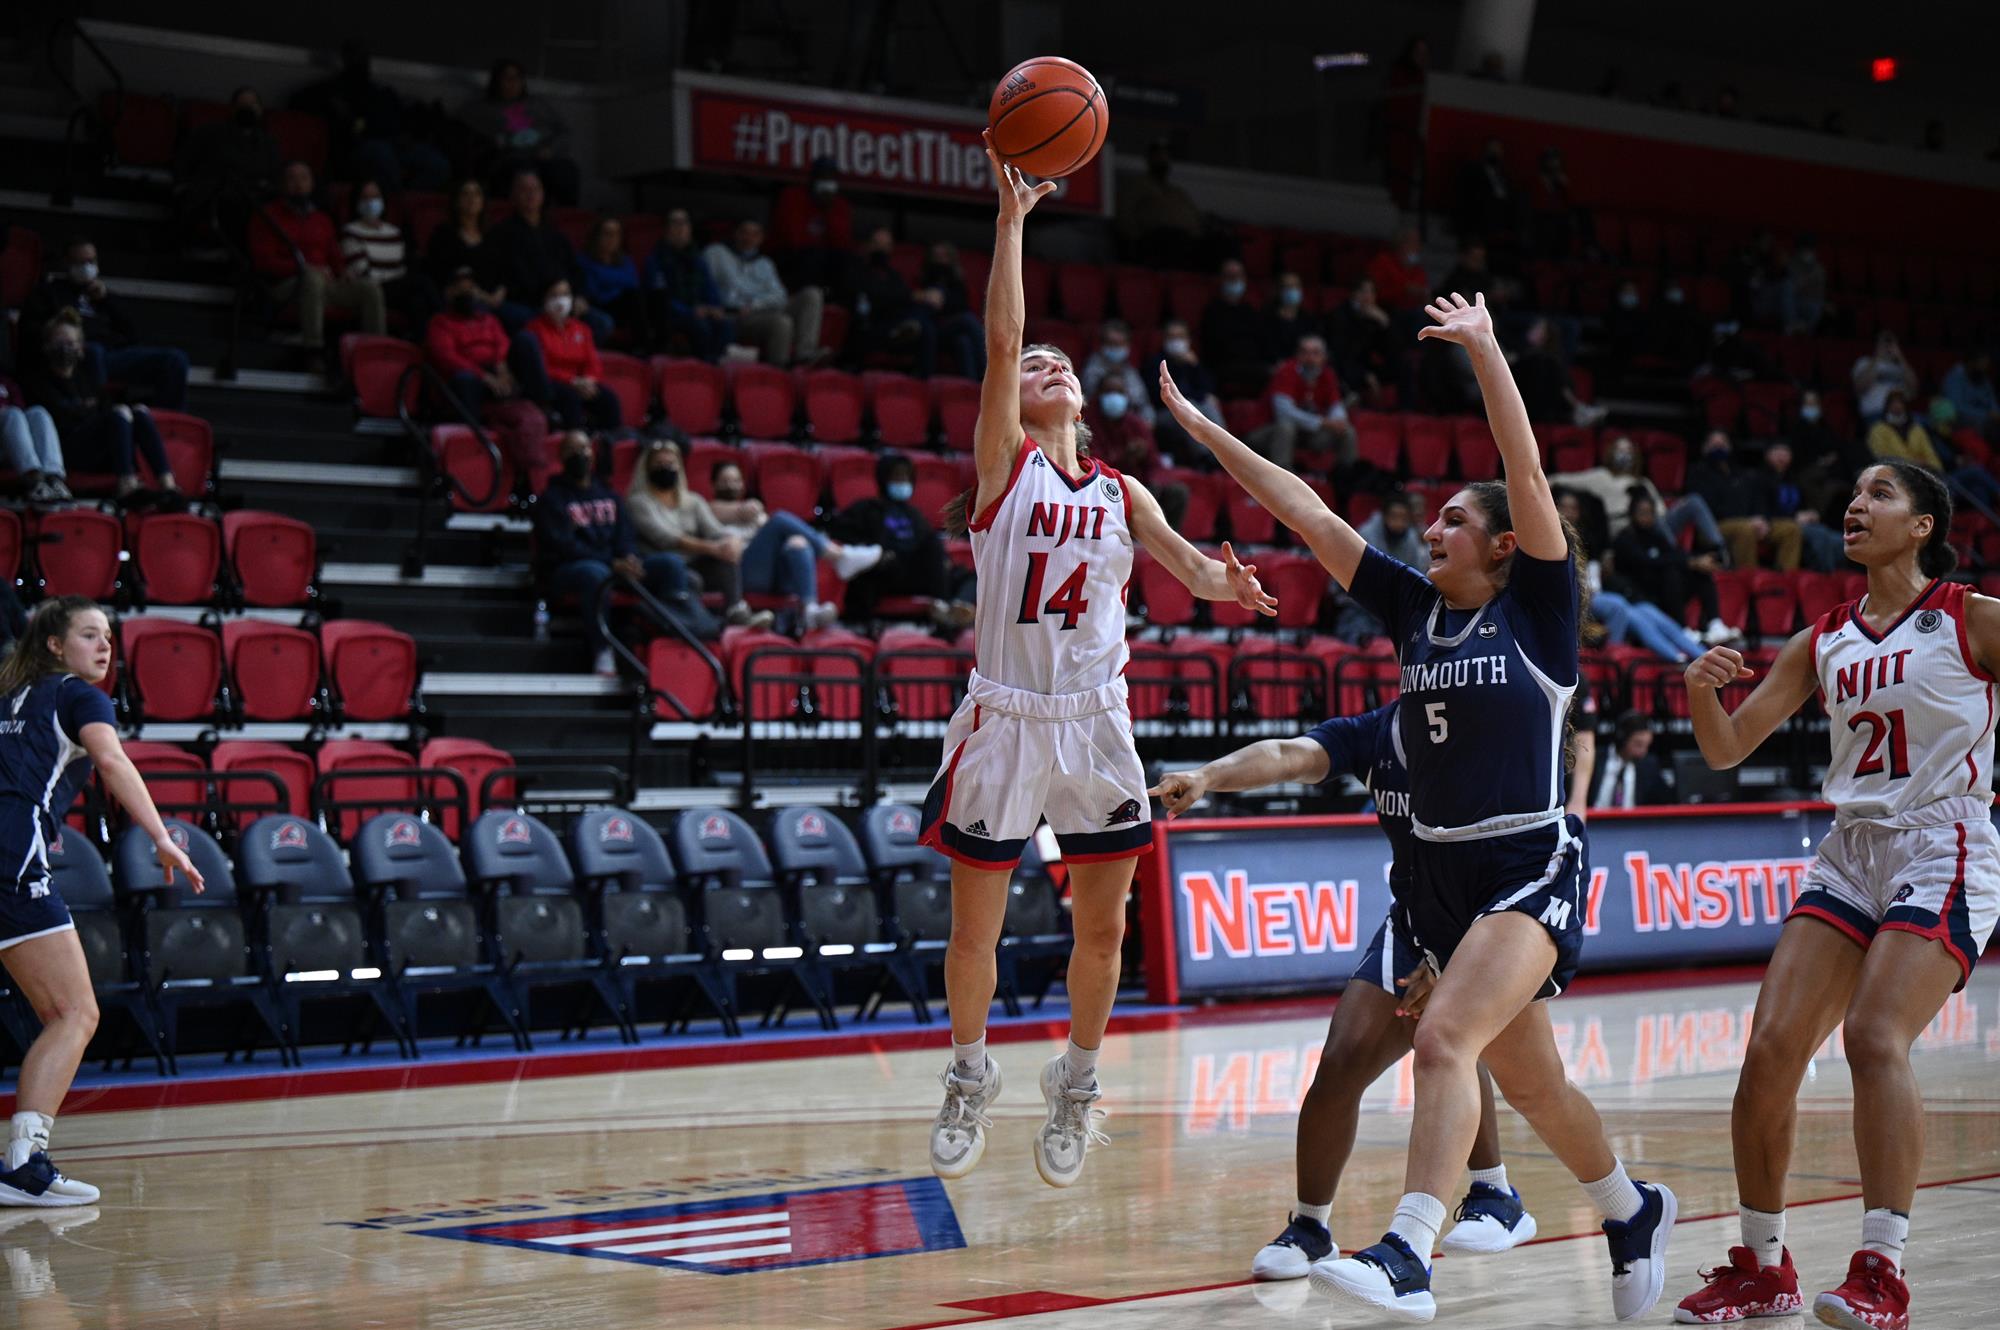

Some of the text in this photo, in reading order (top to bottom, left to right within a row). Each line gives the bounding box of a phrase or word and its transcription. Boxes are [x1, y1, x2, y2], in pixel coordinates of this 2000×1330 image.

[1000, 81, 1036, 106] adidas
[731, 108, 1069, 199] #ProtectThe
[1026, 501, 1109, 548] NJIT
[1016, 552, 1088, 631] 14
[1480, 626, 1496, 634] BLM
[1836, 648, 1914, 705] NJIT
[1424, 701, 1449, 744] 5
[1848, 708, 1912, 781] 21
[1374, 789, 1410, 817] MON
[1538, 895, 1572, 930] M
[1625, 850, 1816, 931] INSTIT
